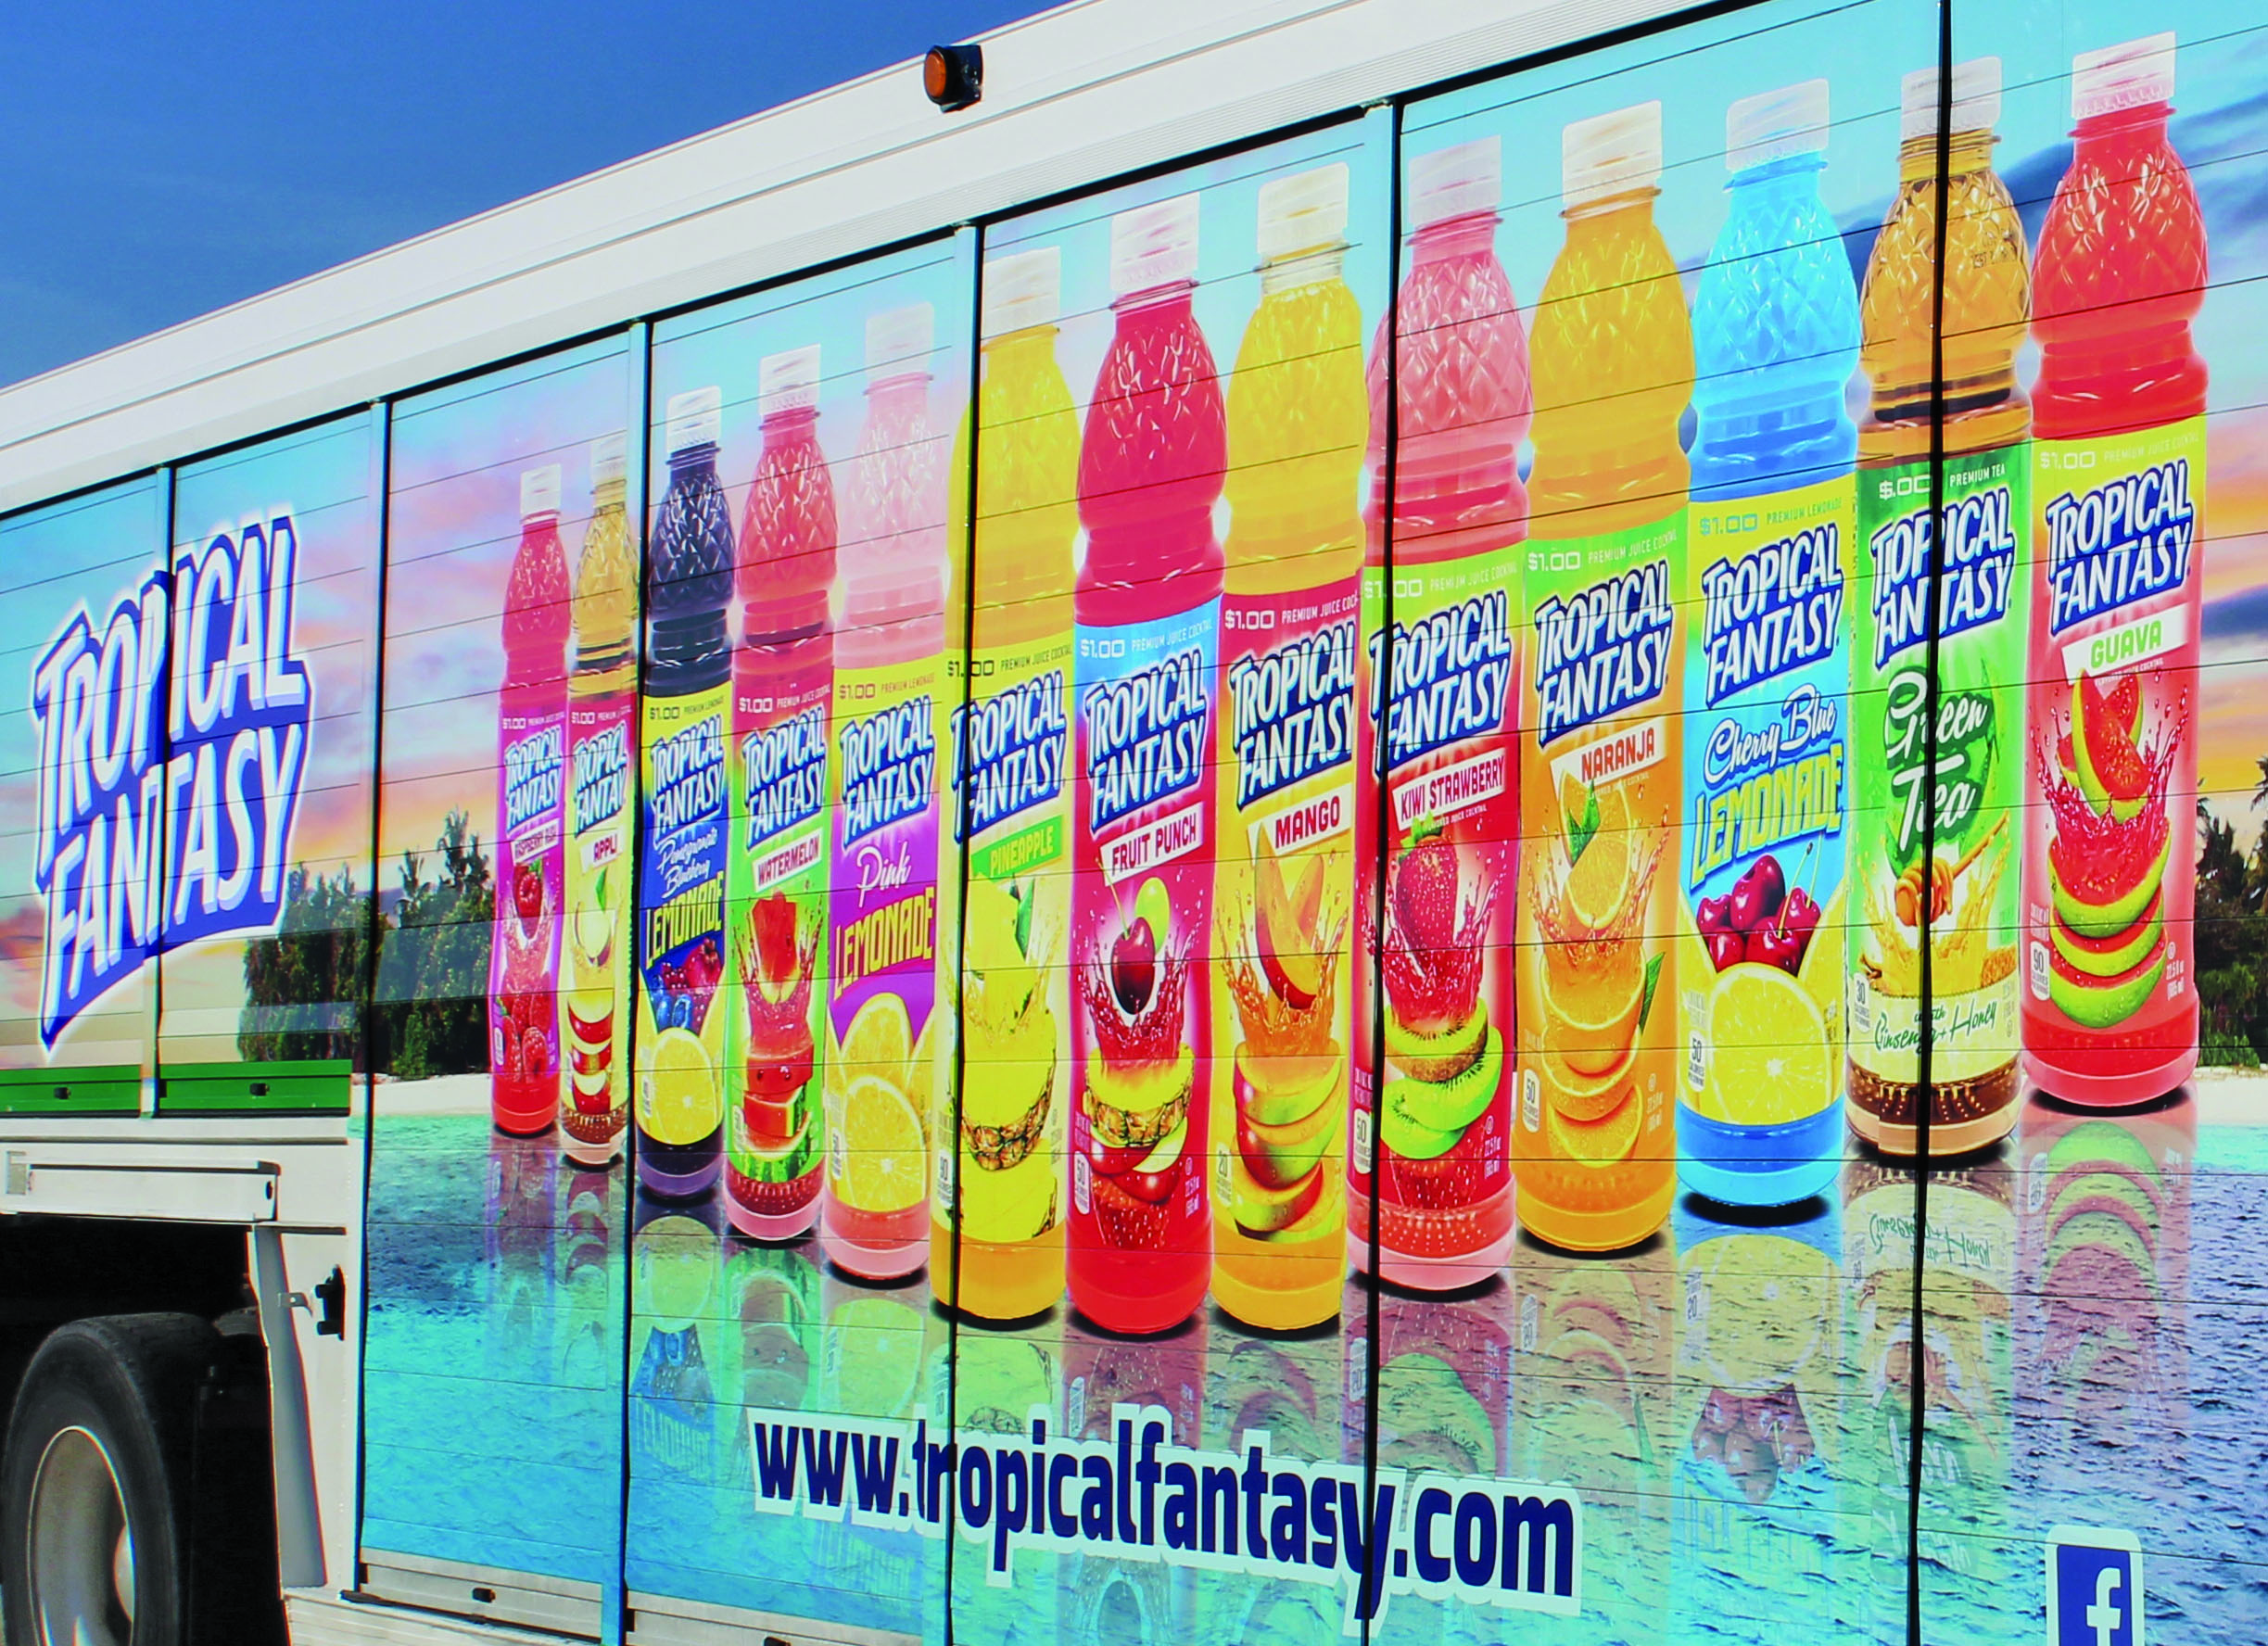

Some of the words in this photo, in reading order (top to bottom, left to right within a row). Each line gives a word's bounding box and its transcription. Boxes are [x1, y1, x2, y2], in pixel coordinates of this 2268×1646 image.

[1949, 467, 1990, 487] PREMIUM
[1992, 463, 2006, 479] TEA
[1527, 551, 1581, 572] $1.00
[1588, 546, 1627, 564] PREMIUM
[1628, 539, 1651, 558] JUICE
[1699, 513, 1758, 536] $1.00
[1767, 509, 1805, 525] PREMIUM
[2046, 461, 2192, 580] TROPICAL
[1224, 609, 1275, 630] $1.00
[1281, 605, 1318, 625] PREMIUM
[1320, 599, 1340, 617] JUICE
[1702, 525, 1843, 650] TROPICAL
[2052, 522, 2190, 634] FANTASY
[1001, 656, 1031, 671] PREMIUM
[1080, 639, 1125, 658] $1.00
[1131, 634, 1165, 652] PREMIUM
[1167, 627, 1187, 646] JUICE
[1371, 594, 1511, 715] TROPICAL
[1536, 561, 1672, 688] TROPICAL
[1707, 589, 1842, 706] FANTASY
[2090, 620, 2161, 668] GUAVA
[35, 524, 308, 877] TROPICAL
[650, 707, 679, 719] $1.00
[739, 697, 773, 714] $1.00
[839, 683, 876, 699] $1.00
[951, 671, 1067, 786] TROPICAL
[1085, 651, 1206, 775] TROPICAL
[1231, 622, 1356, 752] TROPICAL
[1376, 658, 1509, 773] FANTASY
[1539, 627, 1670, 745] FANTASY
[1884, 670, 1988, 759] Green
[505, 725, 563, 791] TROPICAL
[652, 714, 724, 796] TROPICAL
[743, 706, 826, 803] TROPICAL
[840, 696, 935, 799] TROPICAL
[1092, 716, 1205, 829] FANTASY
[1581, 728, 1654, 782] NARANJA
[1704, 718, 1782, 786] Cherry
[1780, 683, 1836, 752] Blue
[506, 767, 562, 833] FANTASY
[654, 761, 723, 842] FANTASY
[747, 760, 825, 850] FANTASY
[843, 753, 933, 847] FANTASY
[1275, 795, 1340, 849] MANGO
[1400, 786, 1425, 822] KIWI
[1429, 754, 1505, 810] STRAWBERRY
[1690, 742, 1844, 890] LEMONADE
[1893, 753, 1977, 852] Tea
[43, 723, 304, 1035] FANTASY
[758, 835, 819, 885] WATERMELON
[856, 840, 911, 908] Pink
[990, 826, 1054, 877] PINEAPPLE
[1111, 833, 1150, 877] FRUIT
[1155, 811, 1197, 852] PUNCH
[646, 870, 725, 970] LEMONADE
[833, 886, 935, 1002] LEMONADE
[1949, 997, 1997, 1043] Honey
[752, 1418, 1574, 1620] www.tropicalfantasy.com
[2085, 1566, 2122, 1646] f
